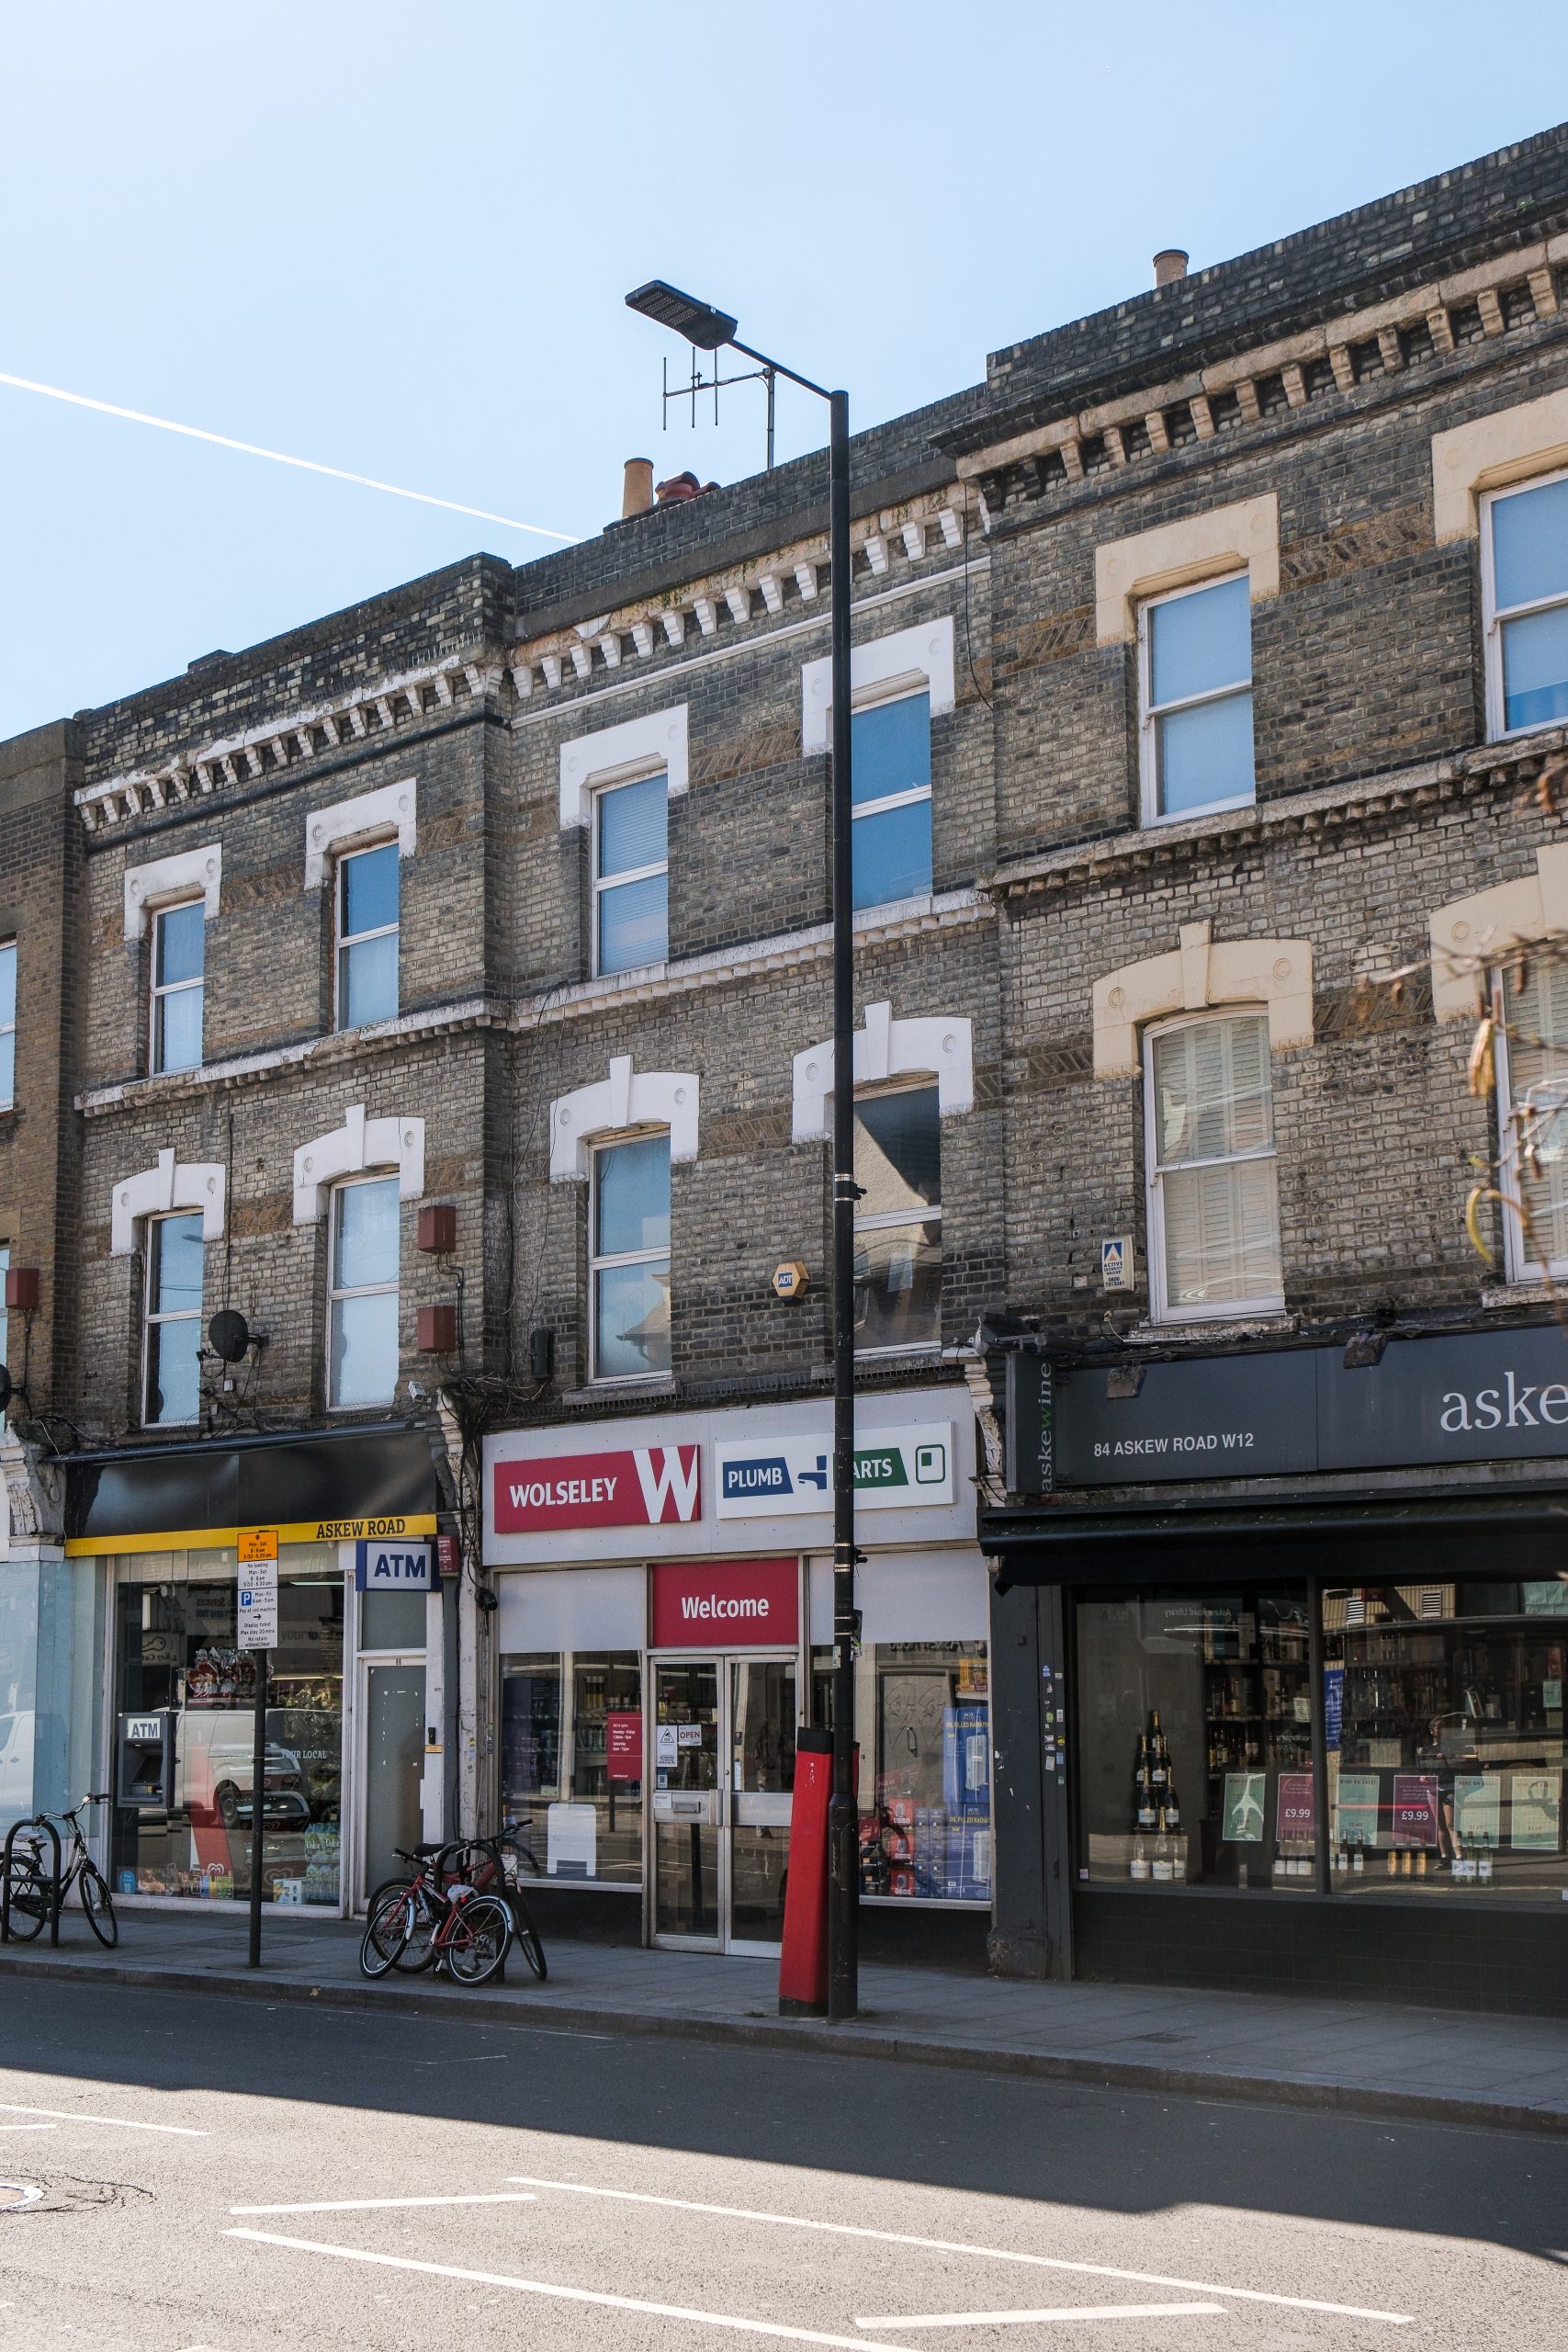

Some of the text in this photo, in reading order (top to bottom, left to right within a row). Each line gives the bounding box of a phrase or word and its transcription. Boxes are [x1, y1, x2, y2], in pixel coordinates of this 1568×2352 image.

[778, 1275, 793, 1285] ADT
[1038, 1363, 1053, 1493] askewine
[1093, 1432, 1255, 1457] 84 ASKEW ROAD W12
[728, 1458, 893, 1489] PLUMB ARTS
[509, 1476, 618, 1509] WOLSELEY
[316, 1519, 406, 1539] ASKEW ROAD
[374, 1554, 426, 1578] ATM
[243, 1592, 251, 1605] P
[681, 1594, 771, 1619] Welcome
[131, 1723, 158, 1738] ATM
[680, 1731, 701, 1739] OPEN
[302, 1750, 328, 1758] LOCAL
[1284, 1808, 1312, 1818] £9.99
[1401, 1811, 1429, 1821] £9.99
